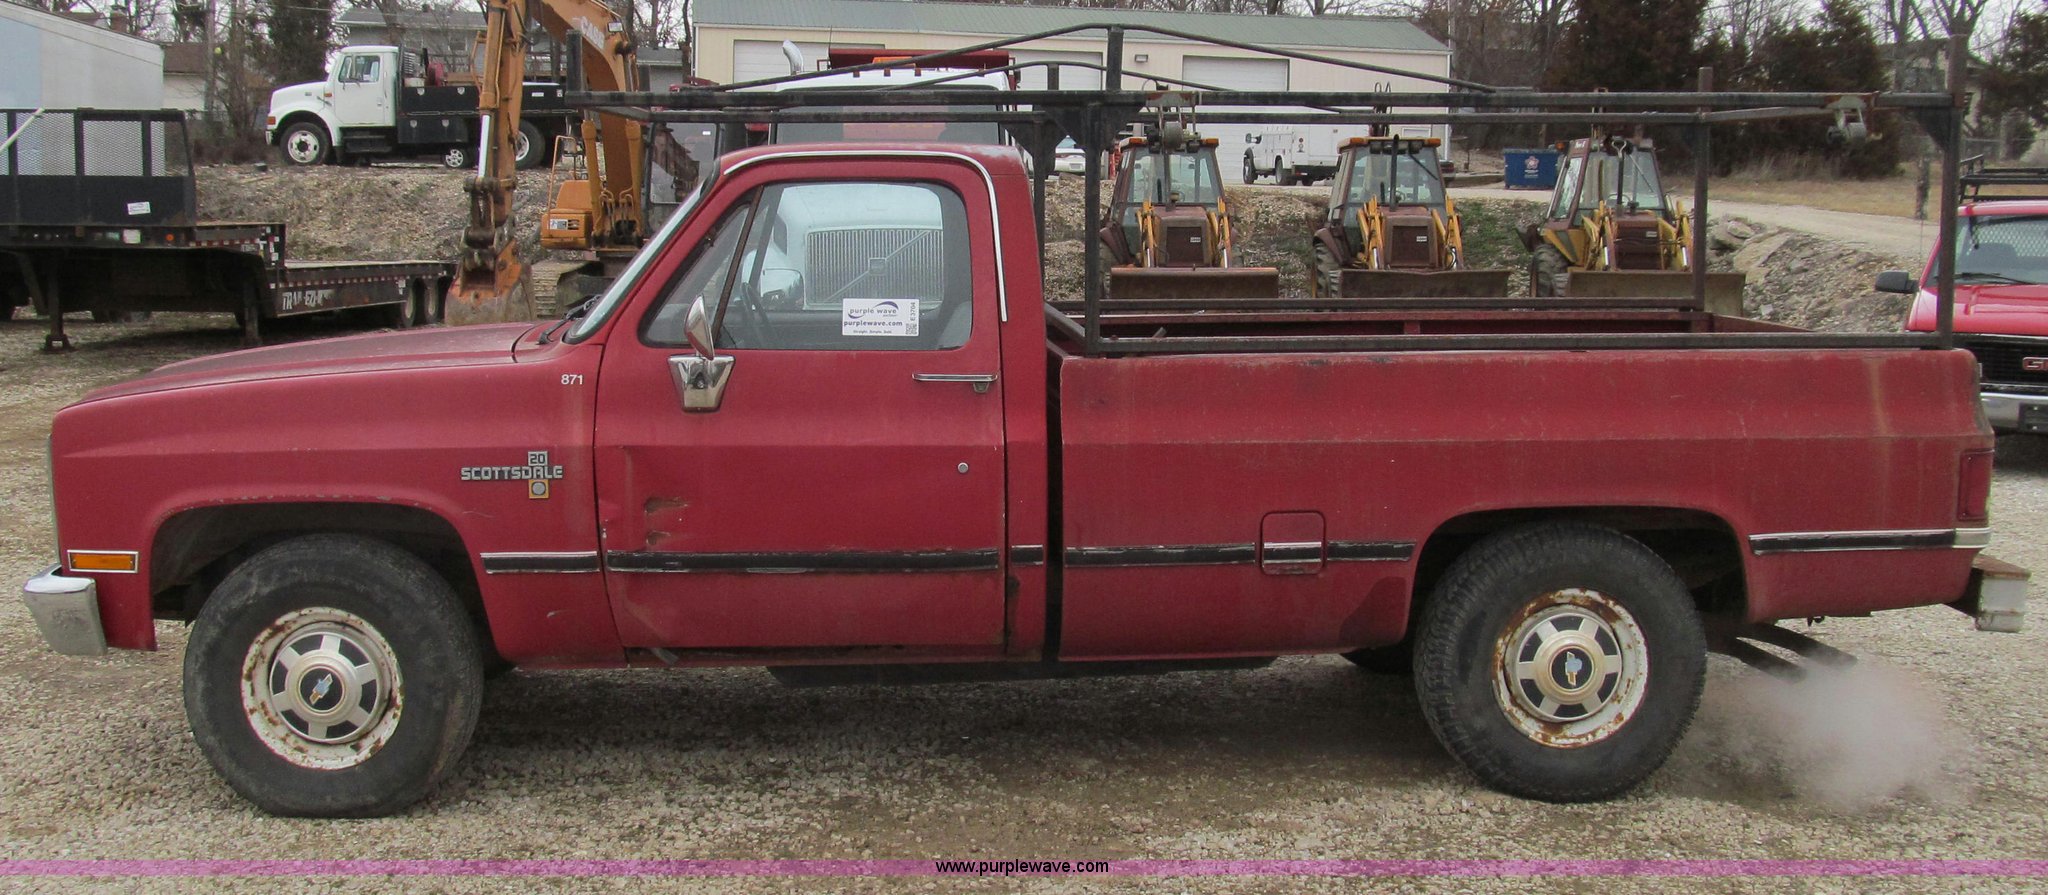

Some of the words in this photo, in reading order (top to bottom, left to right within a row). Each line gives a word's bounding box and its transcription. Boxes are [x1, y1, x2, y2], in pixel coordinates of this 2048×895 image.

[561, 374, 583, 385] 871
[529, 453, 546, 464] 20
[461, 465, 563, 480] SCOTTSDALE
